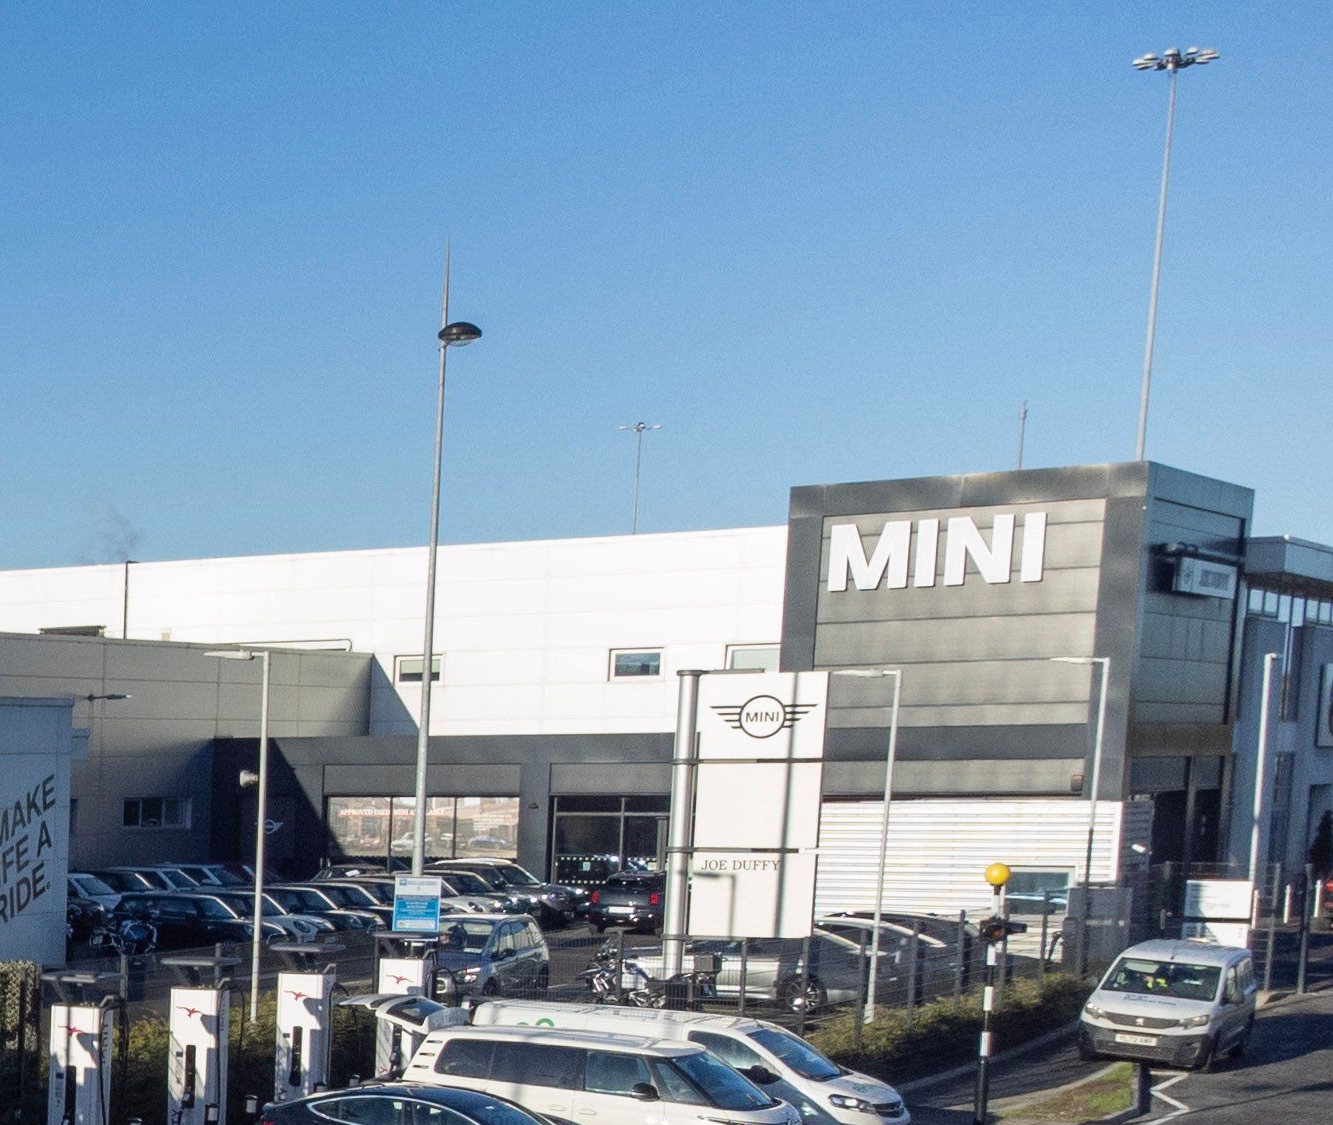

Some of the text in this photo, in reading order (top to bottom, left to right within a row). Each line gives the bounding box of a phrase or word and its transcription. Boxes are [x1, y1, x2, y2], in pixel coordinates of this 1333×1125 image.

[827, 511, 1048, 592] MINI
[745, 711, 780, 723] MINI
[36, 820, 53, 858] A
[701, 859, 782, 871] JOE DUFFY
